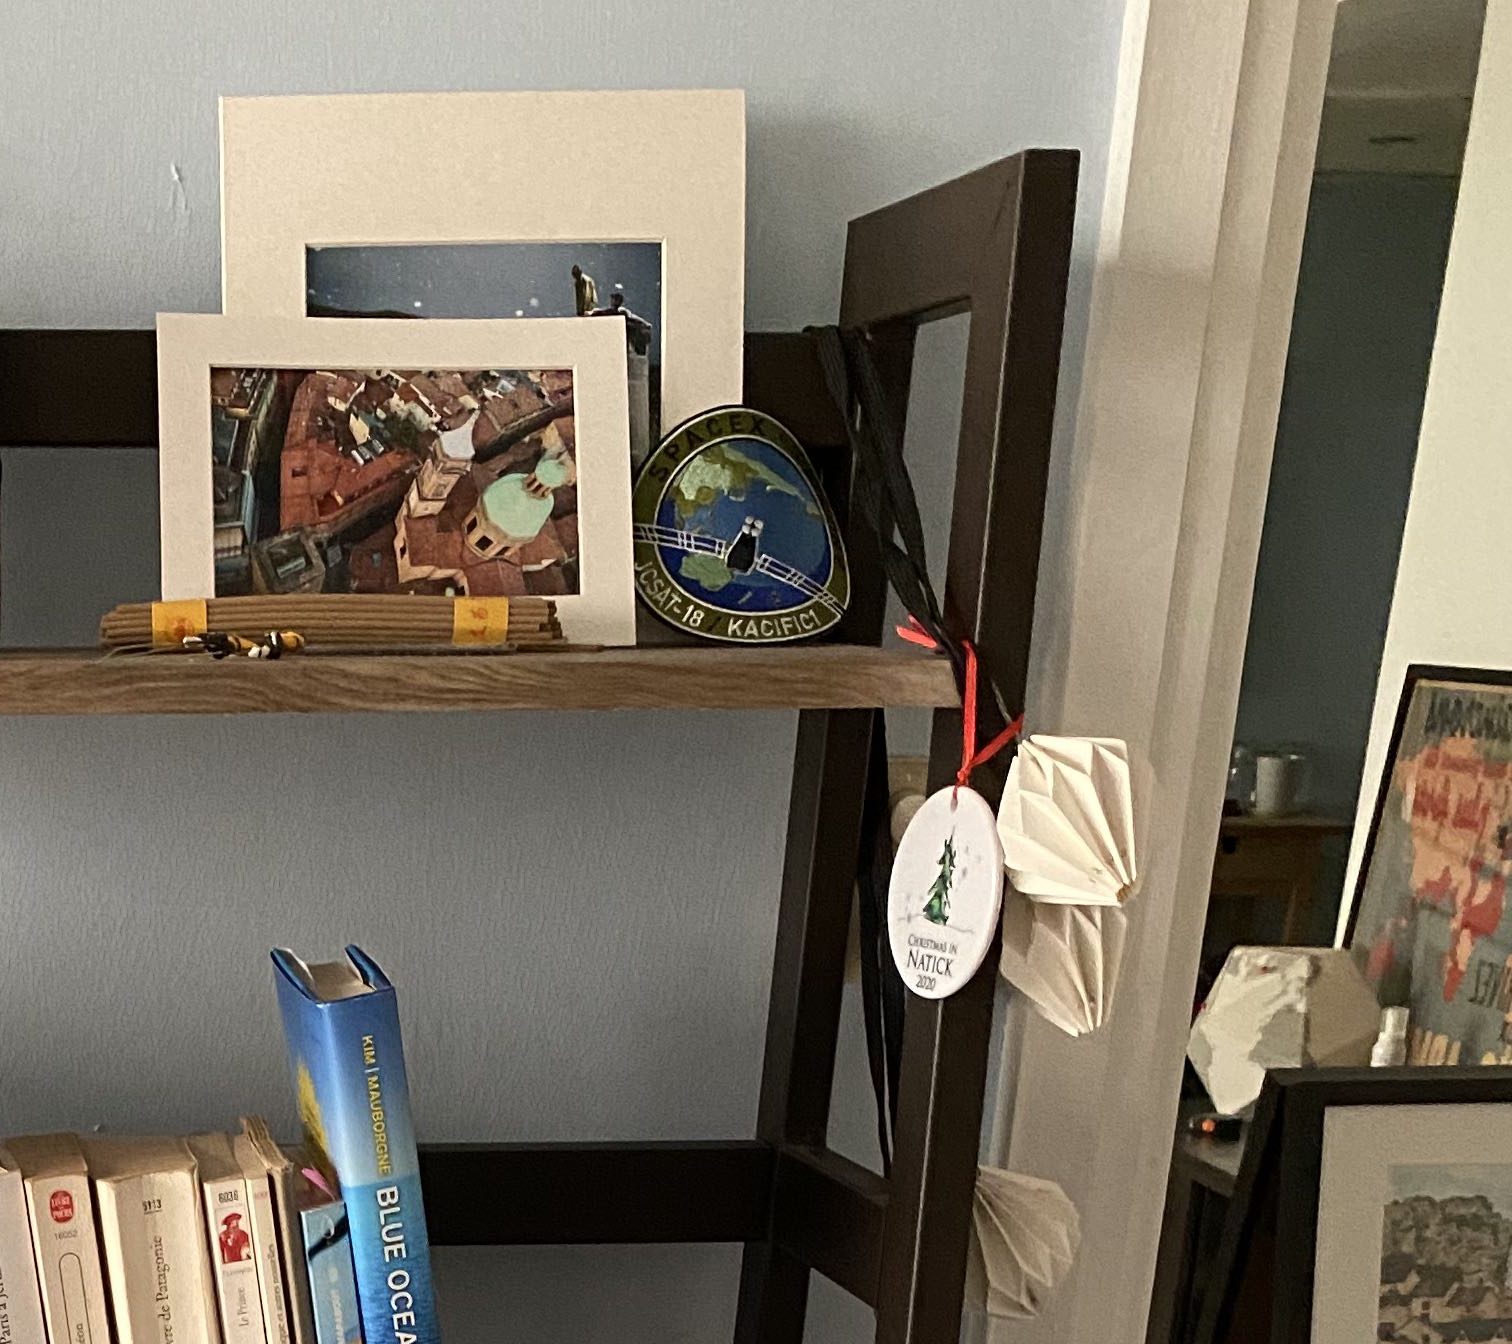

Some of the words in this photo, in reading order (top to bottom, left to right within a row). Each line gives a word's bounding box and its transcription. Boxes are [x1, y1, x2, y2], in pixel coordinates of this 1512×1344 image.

[649, 413, 768, 484] SPACEX
[635, 561, 706, 627] JCSAT-18
[728, 608, 822, 637] KACIFIC1
[906, 948, 954, 977] NATICK
[916, 974, 937, 991] 2020
[362, 1034, 377, 1065] KIM
[367, 1075, 393, 1176] MAUBORGNE
[376, 1185, 407, 1263] BLUE
